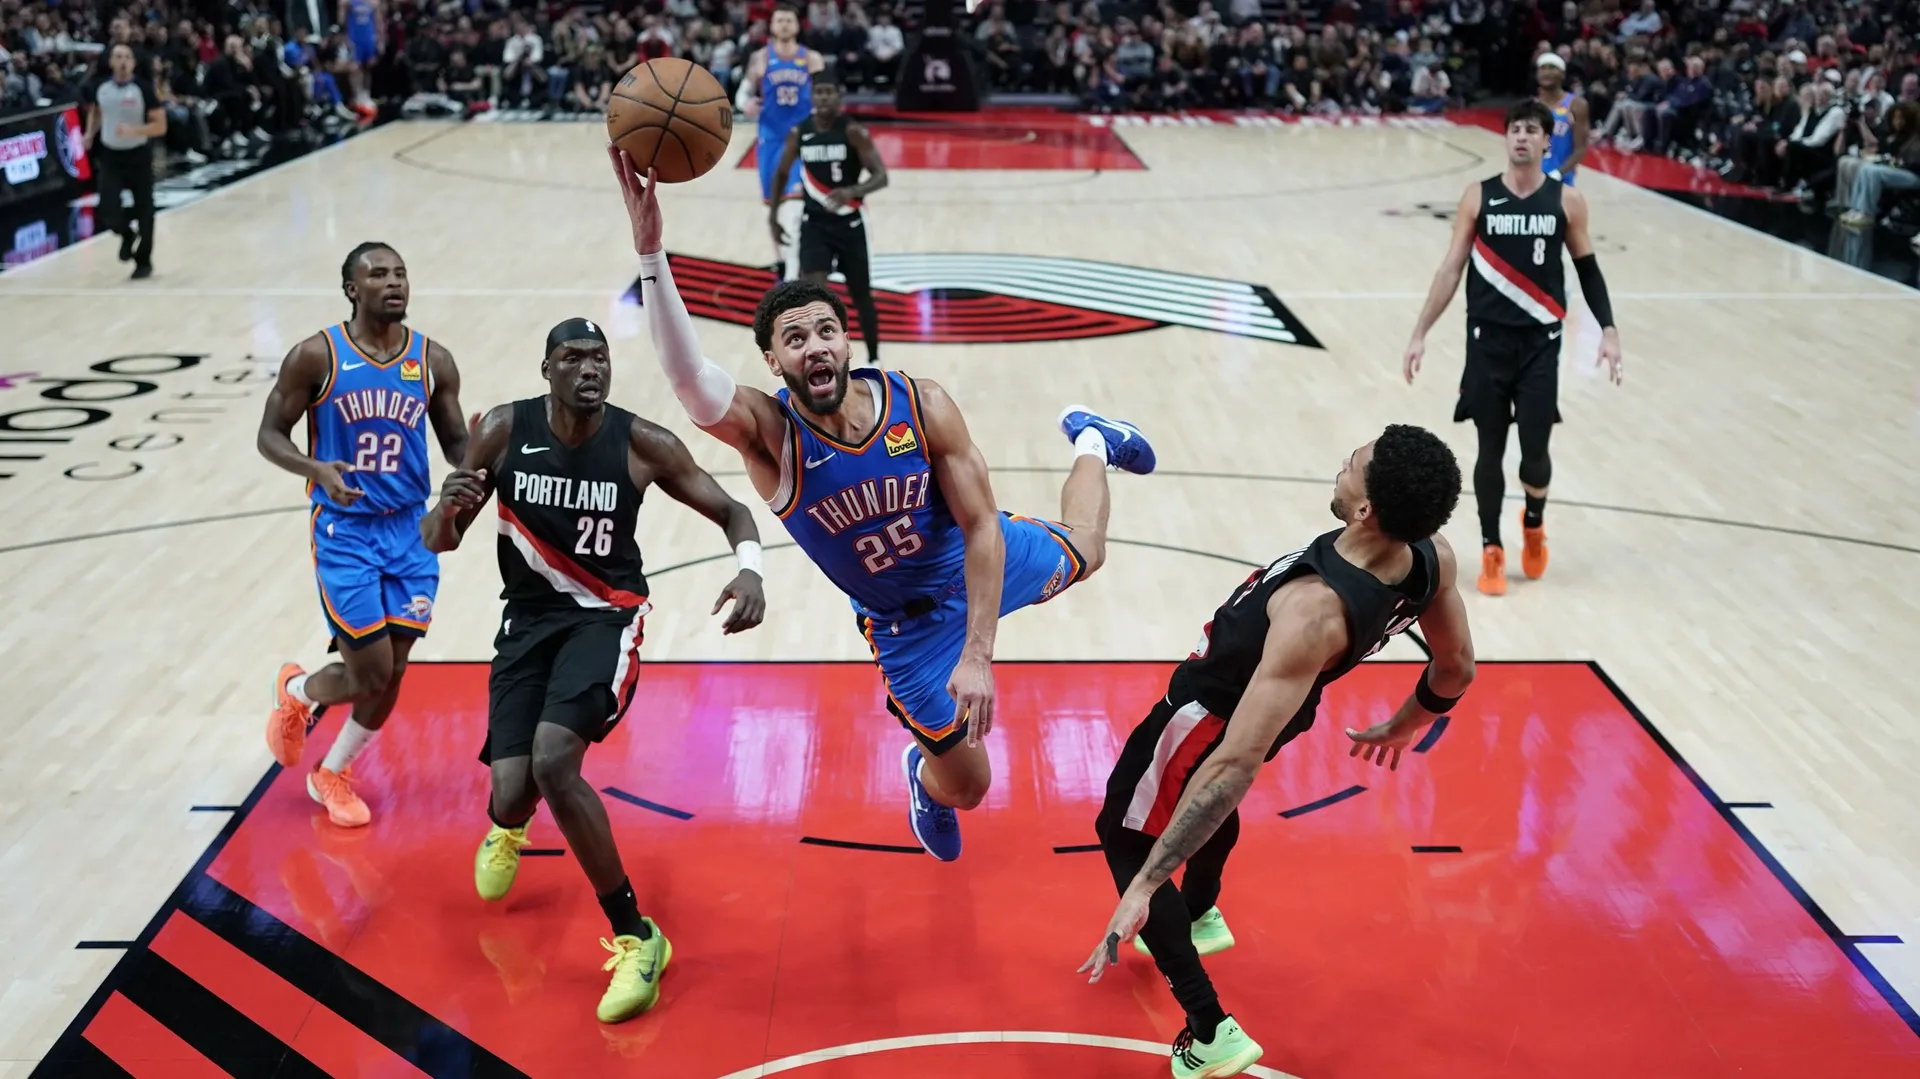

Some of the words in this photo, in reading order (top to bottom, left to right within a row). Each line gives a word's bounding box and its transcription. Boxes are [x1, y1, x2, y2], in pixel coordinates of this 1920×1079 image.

[776, 86, 799, 106] 55
[831, 162, 842, 182] 5
[1486, 214, 1557, 236] PORTLAND
[1532, 237, 1546, 266] 8
[334, 389, 426, 429] THUNDER
[356, 431, 402, 472] 22
[513, 470, 618, 512] PORTLAND
[807, 470, 931, 535] THUNDER
[574, 516, 614, 557] 26
[854, 514, 923, 575] 25
